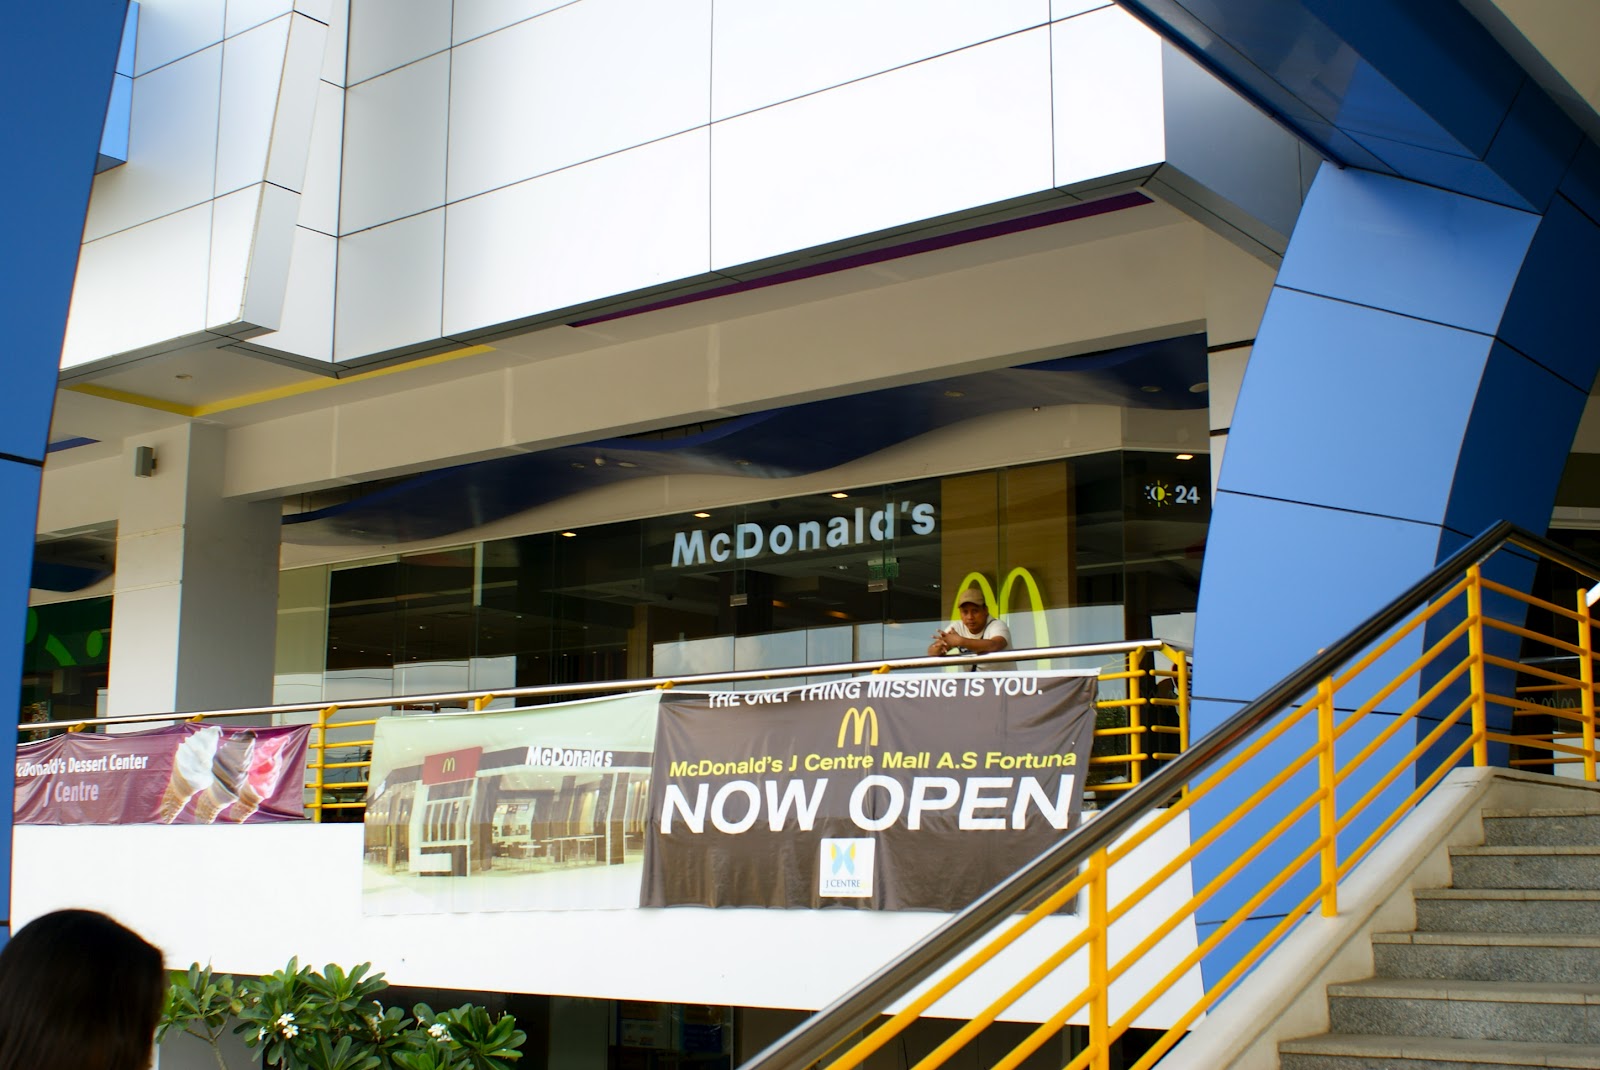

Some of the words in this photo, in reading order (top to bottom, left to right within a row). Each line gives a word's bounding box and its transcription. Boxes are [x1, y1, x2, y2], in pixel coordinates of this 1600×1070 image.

[1174, 484, 1200, 504] 24
[671, 501, 936, 568] McDonald's
[708, 693, 741, 709] THE
[800, 681, 861, 701] THING
[867, 678, 958, 699] MISSING
[964, 678, 985, 697] IS
[992, 677, 1043, 696] YOU.
[68, 755, 108, 773] Dessert
[109, 753, 149, 770] Center
[669, 756, 783, 777] McDonald's
[788, 755, 798, 772] J
[804, 753, 874, 772] Centre
[882, 751, 930, 769] Mall
[936, 752, 978, 769] A.S
[984, 752, 1077, 770] Fortuna
[43, 782, 50, 808] J
[54, 781, 99, 803] Centre
[660, 778, 829, 835] NOW
[848, 773, 1076, 832] OPEN
[830, 879, 861, 888] CENTRE
